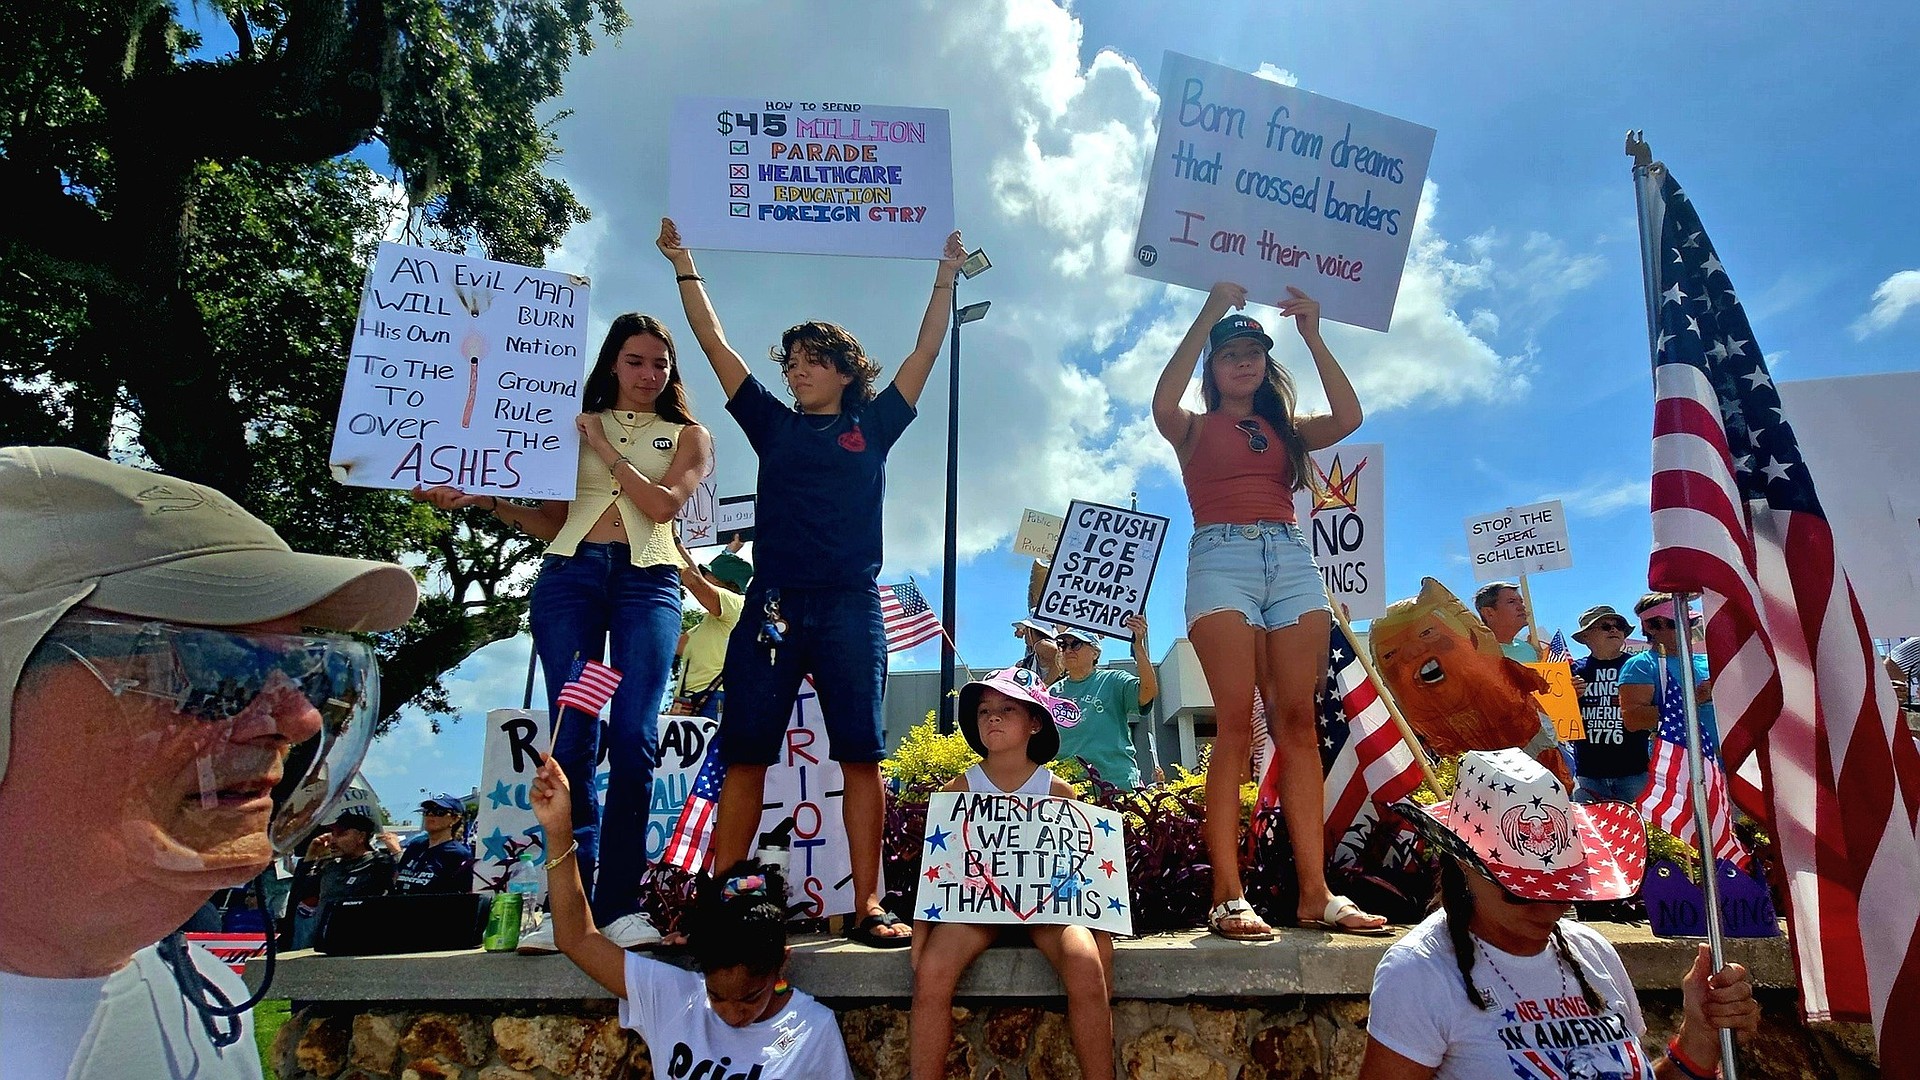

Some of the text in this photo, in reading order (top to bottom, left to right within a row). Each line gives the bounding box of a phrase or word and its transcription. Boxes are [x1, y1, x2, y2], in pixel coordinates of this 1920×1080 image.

[764, 101, 862, 113] HOW TO SPEND
[717, 110, 927, 144] $45 MILLION
[1178, 77, 1405, 185] Born from dreams
[771, 143, 878, 163] PARADE
[758, 164, 903, 185] HEALTHCARE
[1171, 139, 1402, 236] that crossed borders
[774, 185, 892, 205] EDUCATION
[758, 204, 928, 224] FOREIGN CTRY
[1139, 250, 1156, 263] FDT
[1169, 209, 1363, 283] I am their voice
[374, 289, 575, 329] WILL BURN
[497, 371, 577, 399] Ground
[390, 442, 524, 490] ASHES
[1027, 511, 1051, 527] Public
[1078, 508, 1157, 541] CRUSH
[1472, 509, 1553, 535] STOP THE
[1082, 533, 1139, 563] ICE
[1312, 512, 1364, 557] NO
[1476, 540, 1566, 565] SCHLEMIEL
[1063, 552, 1133, 584] STOP
[1319, 561, 1368, 595] INGS
[1057, 573, 1138, 603] TRUMP'S
[1595, 668, 1617, 681] NO
[1600, 696, 1611, 706] IN
[1586, 729, 1624, 745] 1776
[1587, 720, 1623, 729] SINCE
[786, 673, 826, 918] TRIOTS
[950, 793, 1078, 828] AMERICA
[977, 824, 1091, 853] WE ARE
[964, 850, 1094, 883] BETTER
[938, 883, 1101, 919] THAN THIS
[1658, 899, 1698, 930] NO
[1498, 1026, 1531, 1050] IN
